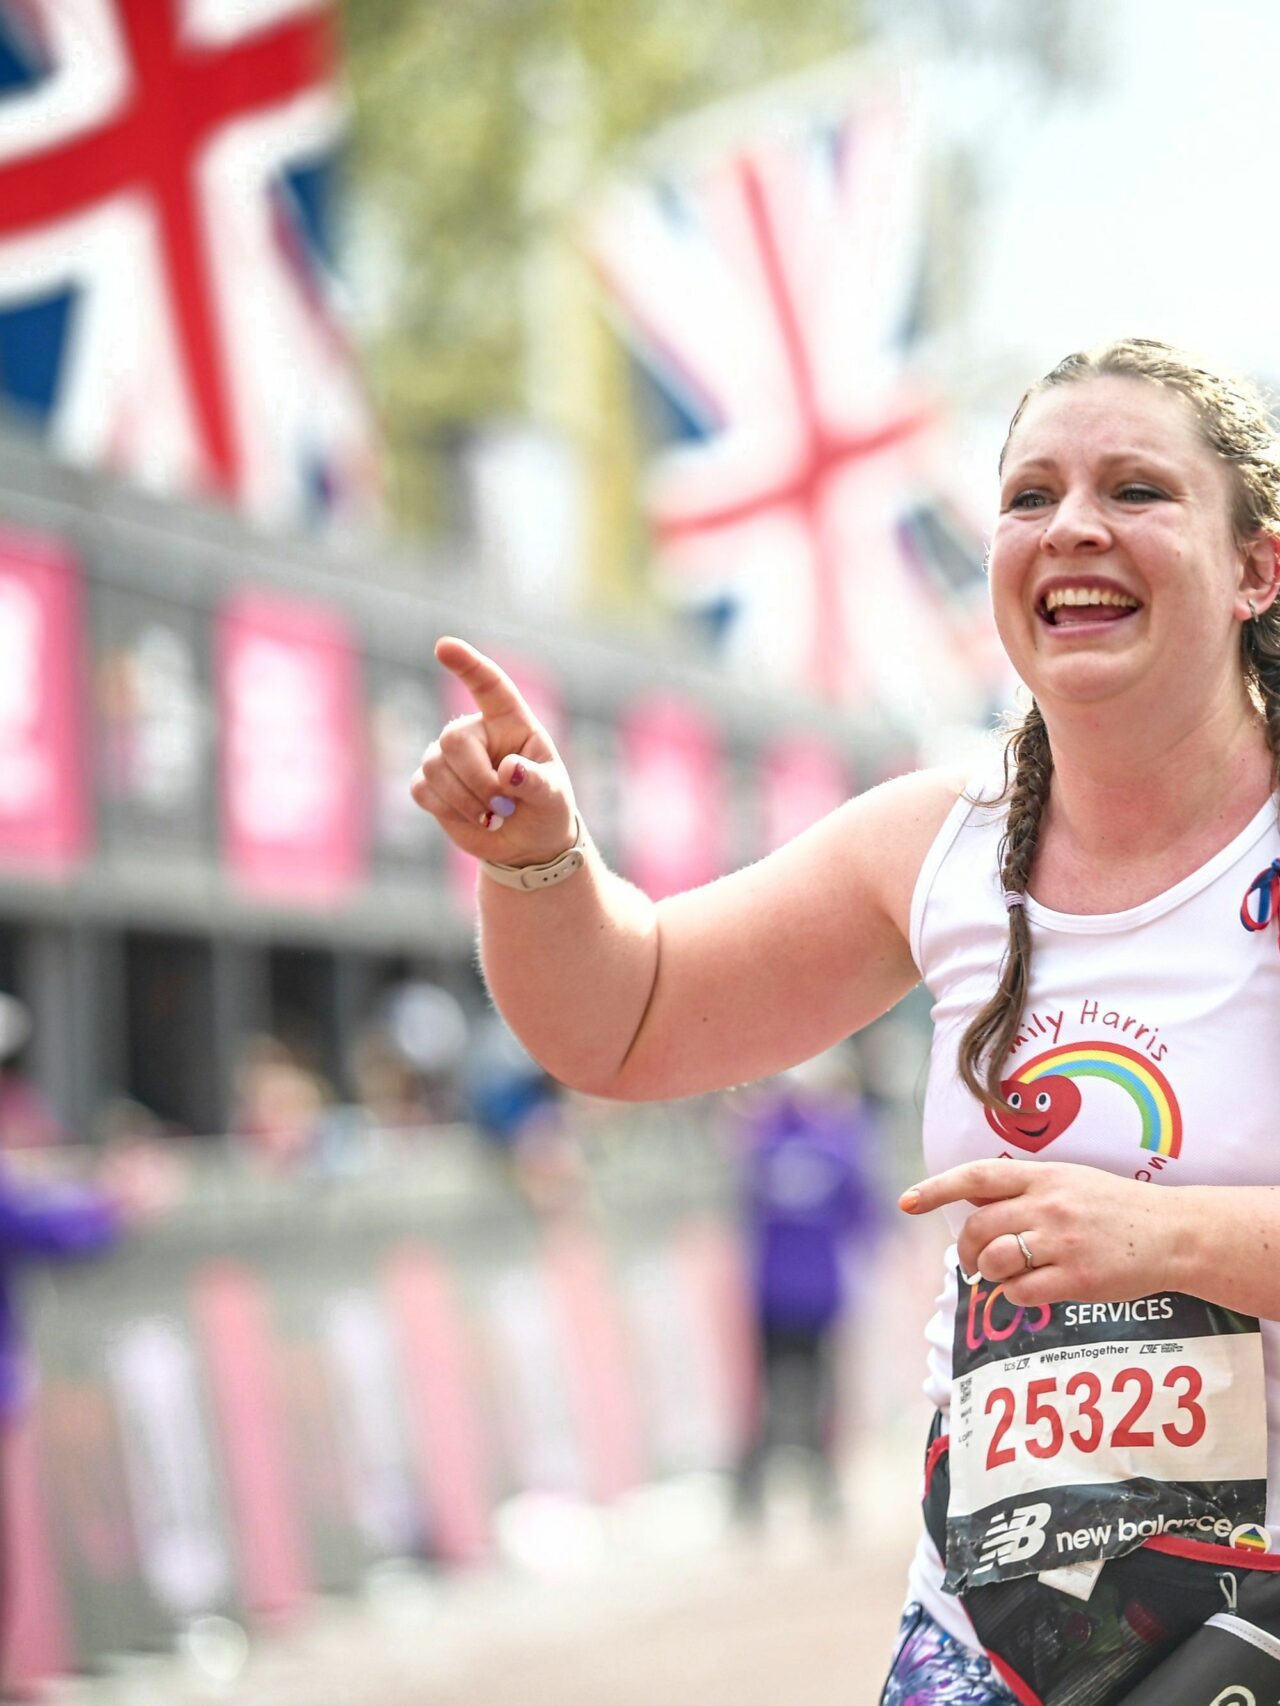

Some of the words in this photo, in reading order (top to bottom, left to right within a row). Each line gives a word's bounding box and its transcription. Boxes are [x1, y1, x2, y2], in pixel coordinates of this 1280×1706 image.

[1008, 1010, 1064, 1054] mily
[1080, 998, 1169, 1062] Harris
[1064, 1298, 1174, 1327] SERVICES
[1040, 1345, 1130, 1364] #WeRunTogether
[984, 1365, 1207, 1472] 25323
[1056, 1524, 1112, 1553] new
